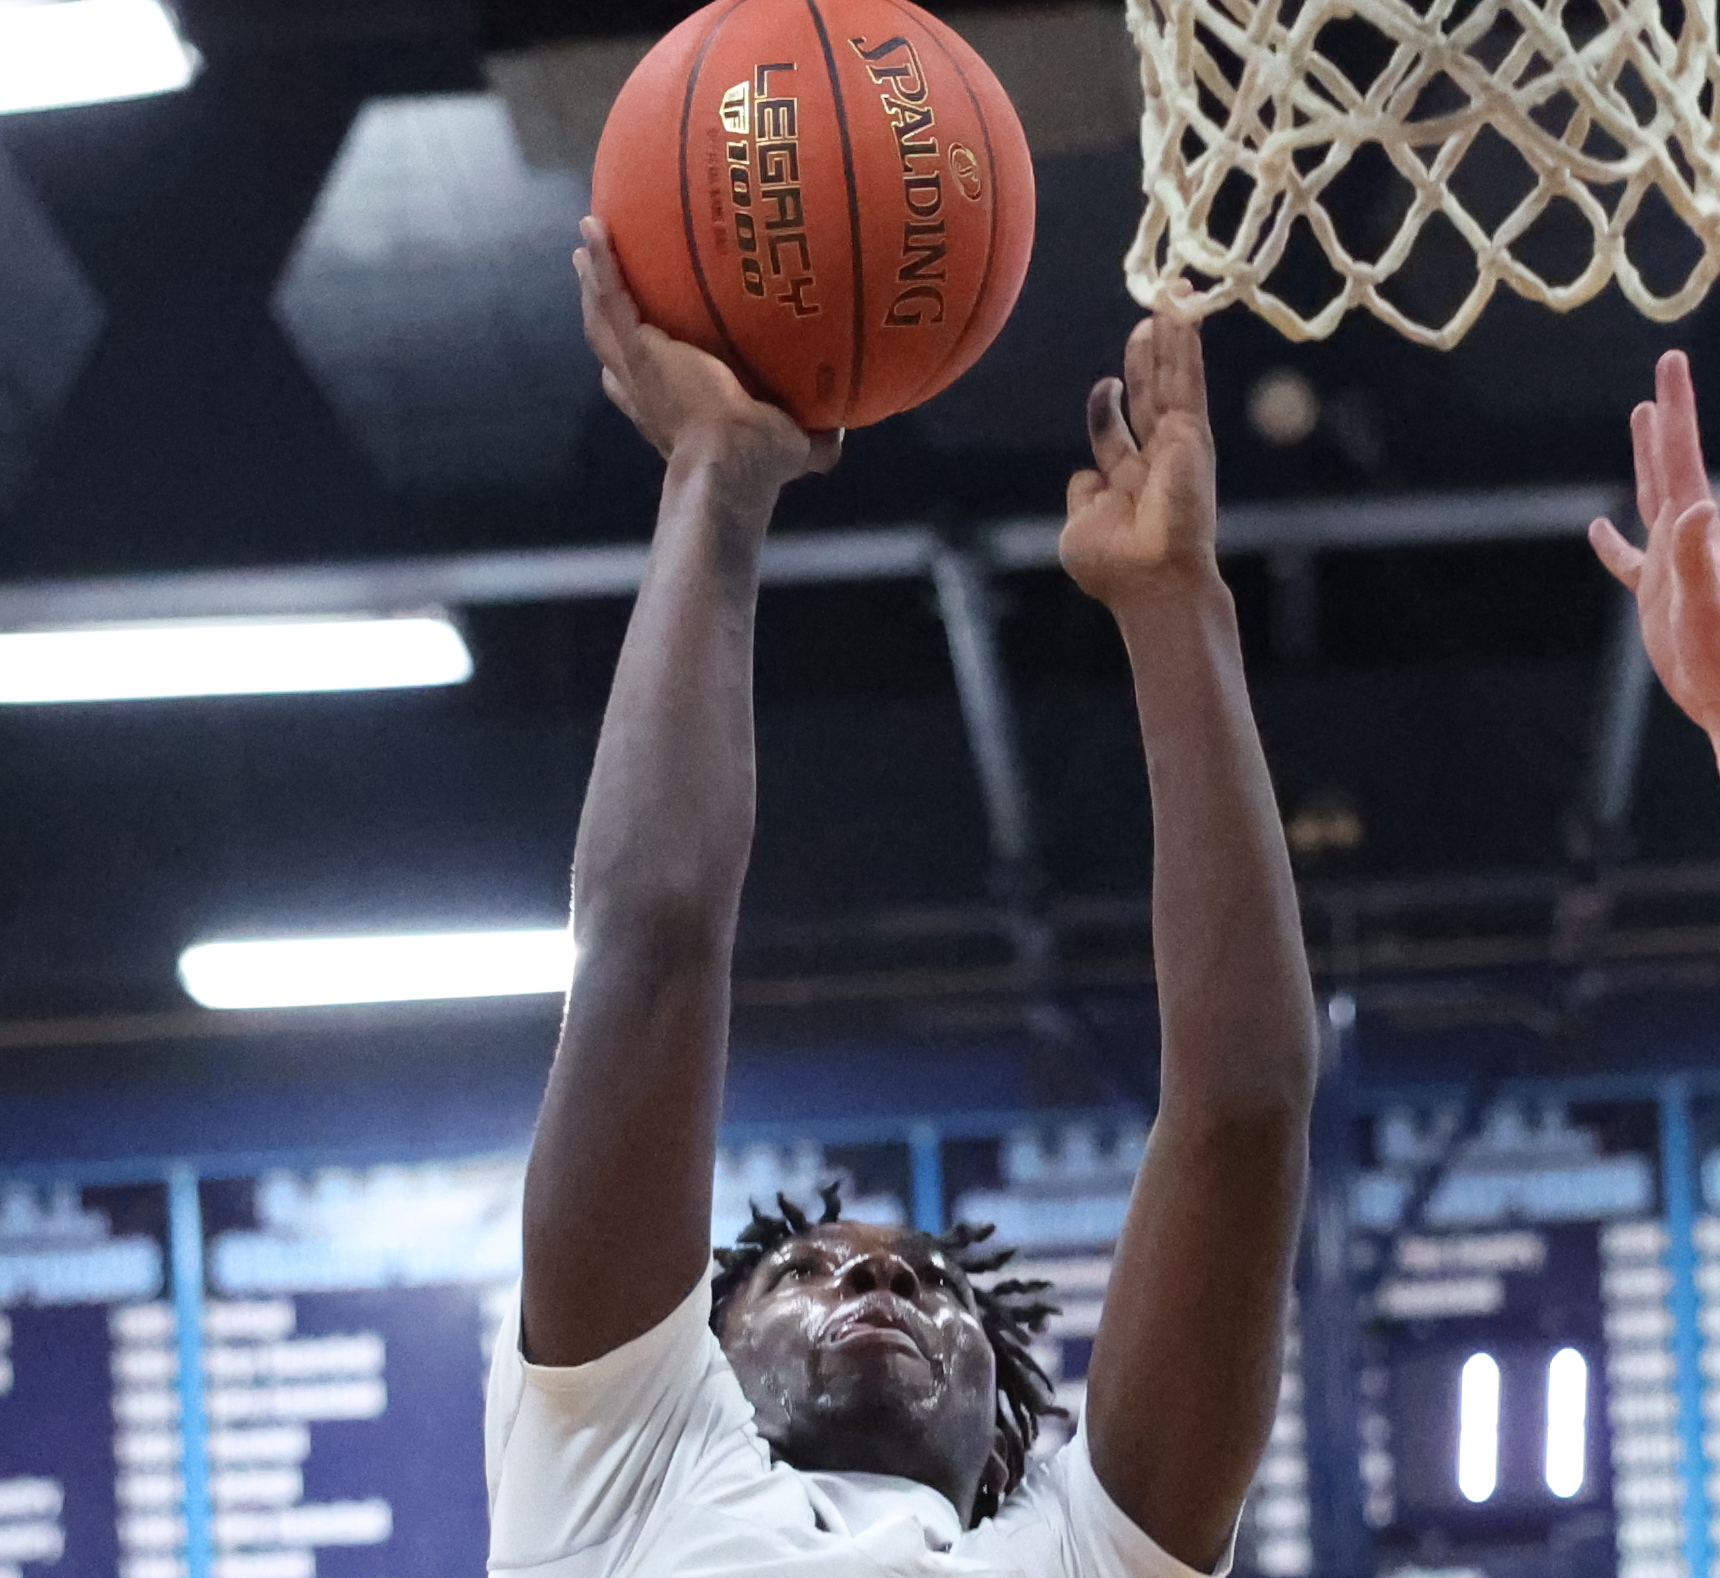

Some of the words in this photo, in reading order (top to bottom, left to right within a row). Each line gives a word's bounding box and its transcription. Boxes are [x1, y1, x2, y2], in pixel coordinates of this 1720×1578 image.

[754, 62, 821, 319] LEGACY
[848, 36, 946, 329] SPALDING
[1458, 1347, 1587, 1502] 11
